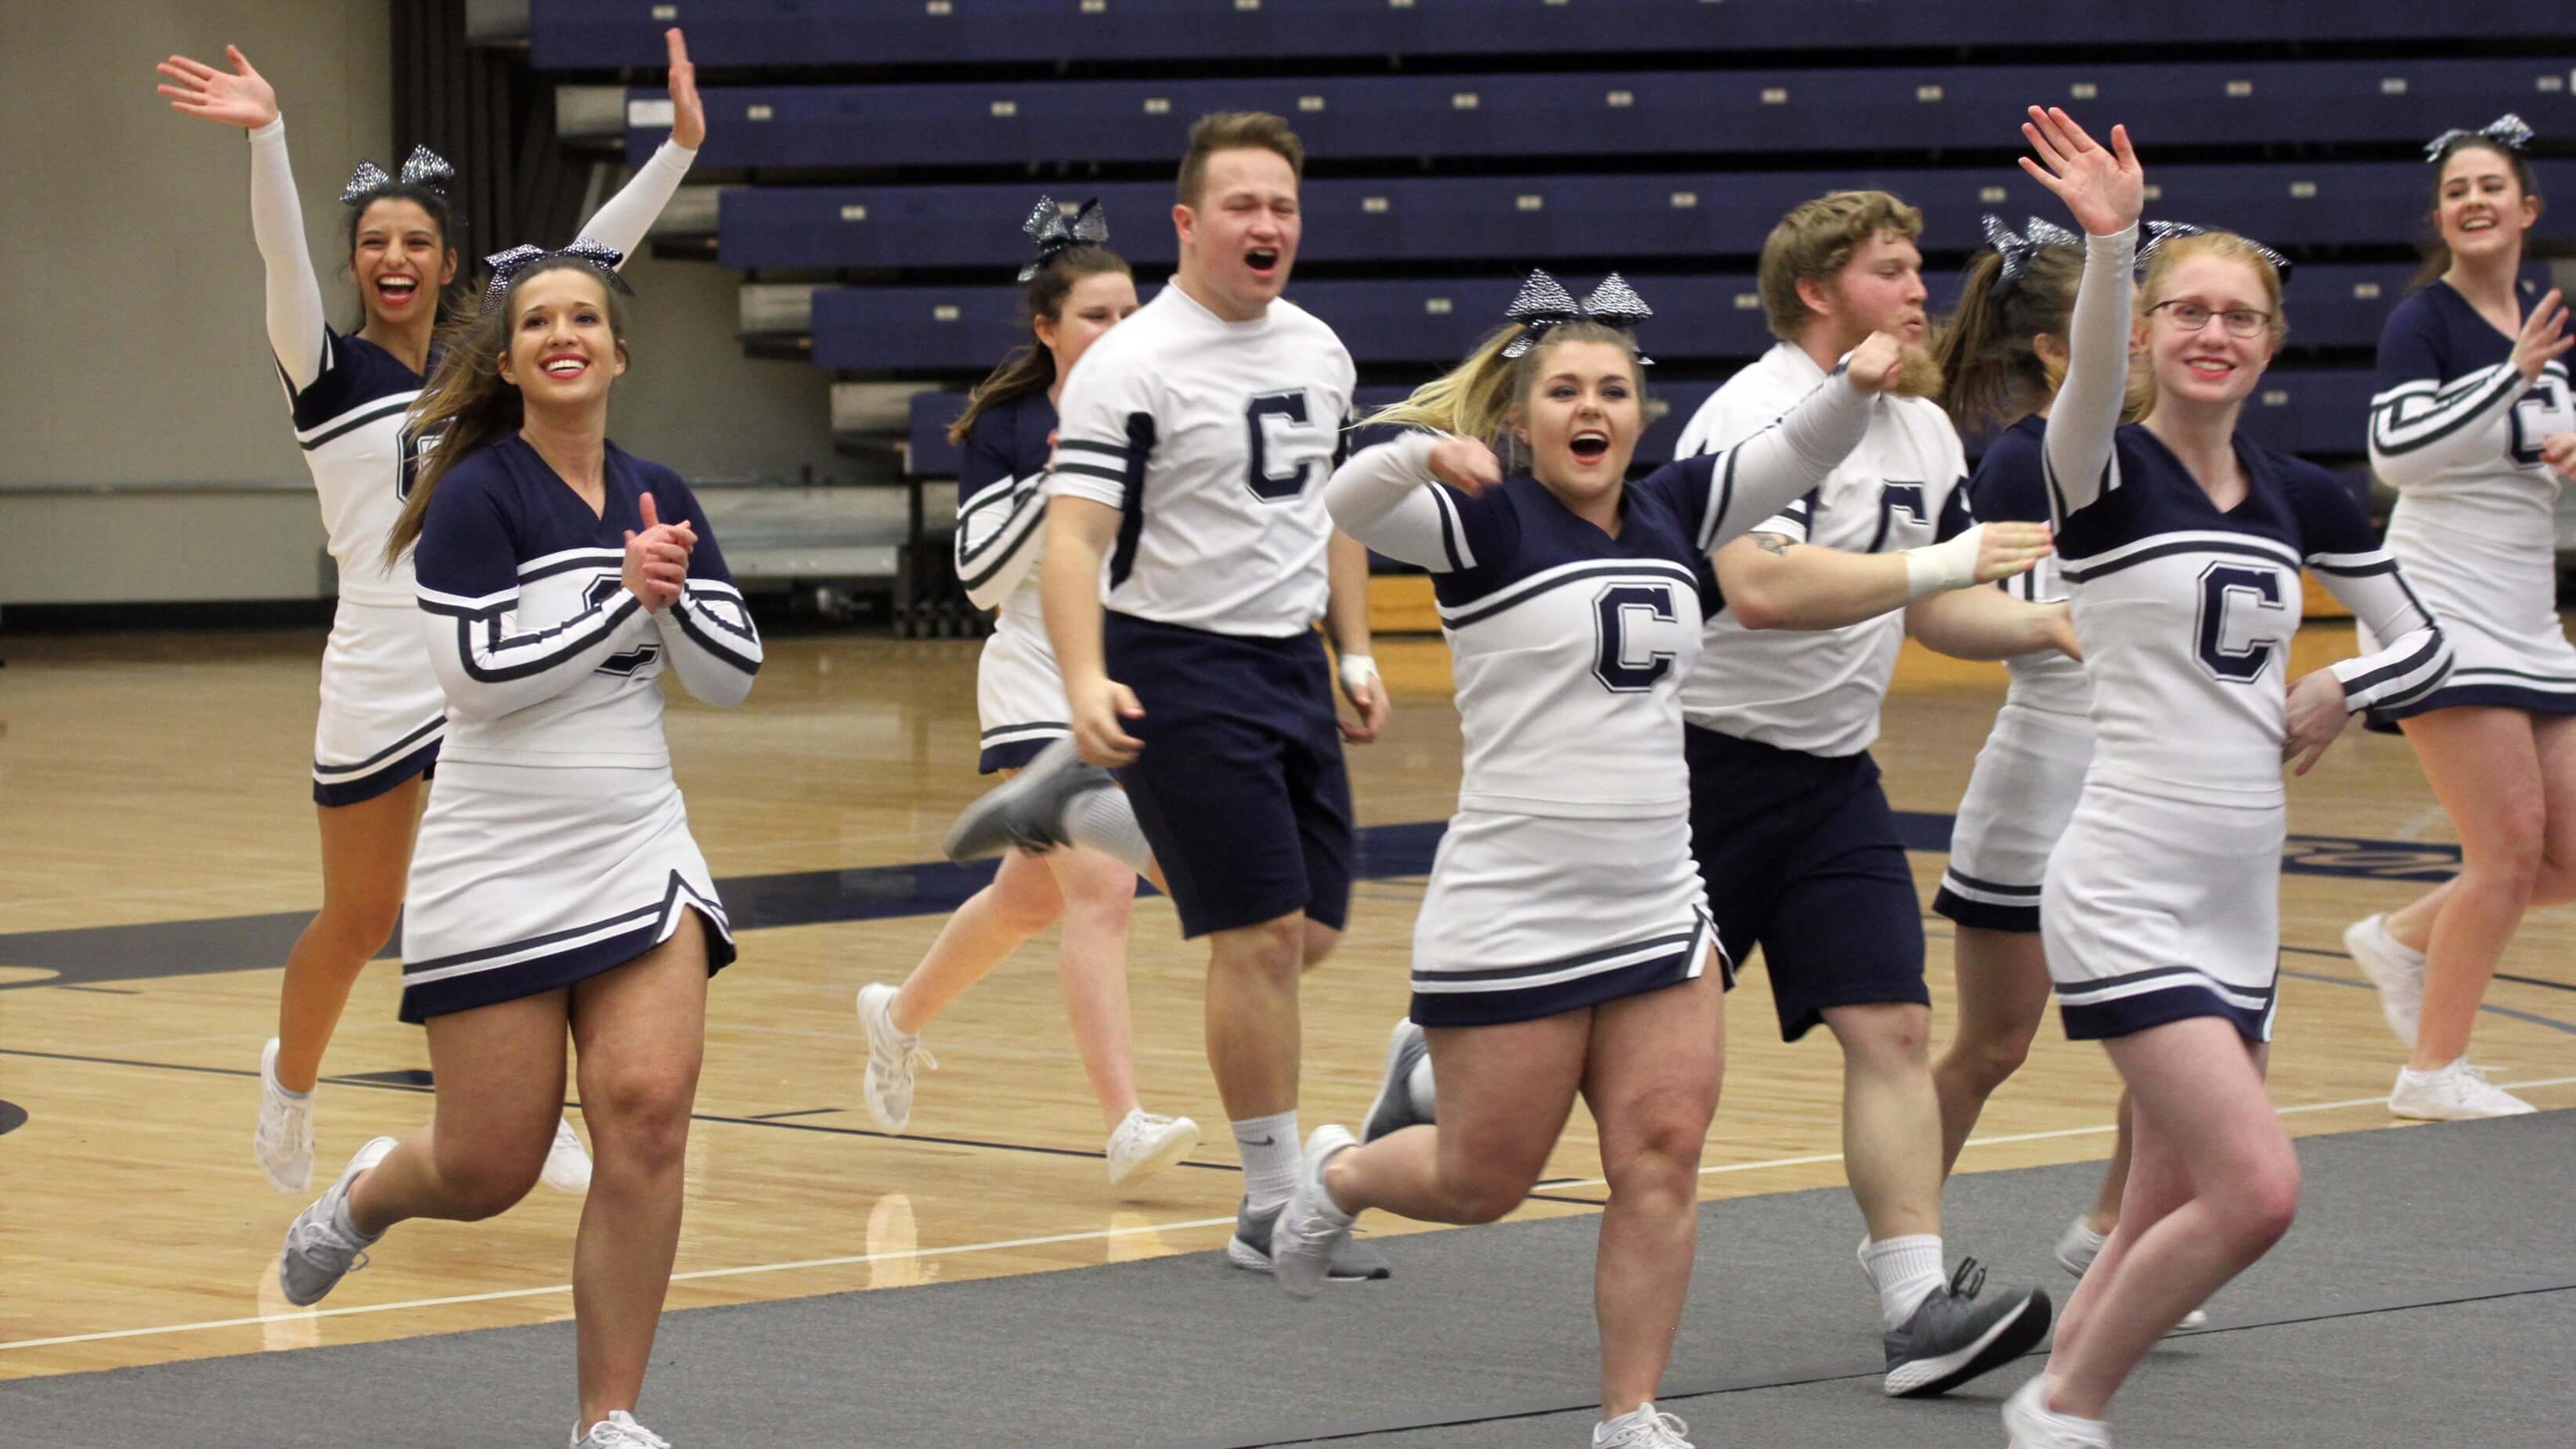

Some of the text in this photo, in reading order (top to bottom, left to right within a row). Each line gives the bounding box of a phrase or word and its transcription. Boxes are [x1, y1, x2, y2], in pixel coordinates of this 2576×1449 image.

[1243, 387, 1314, 504] C
[1591, 582, 1679, 694] C
[2194, 560, 2286, 684] C
